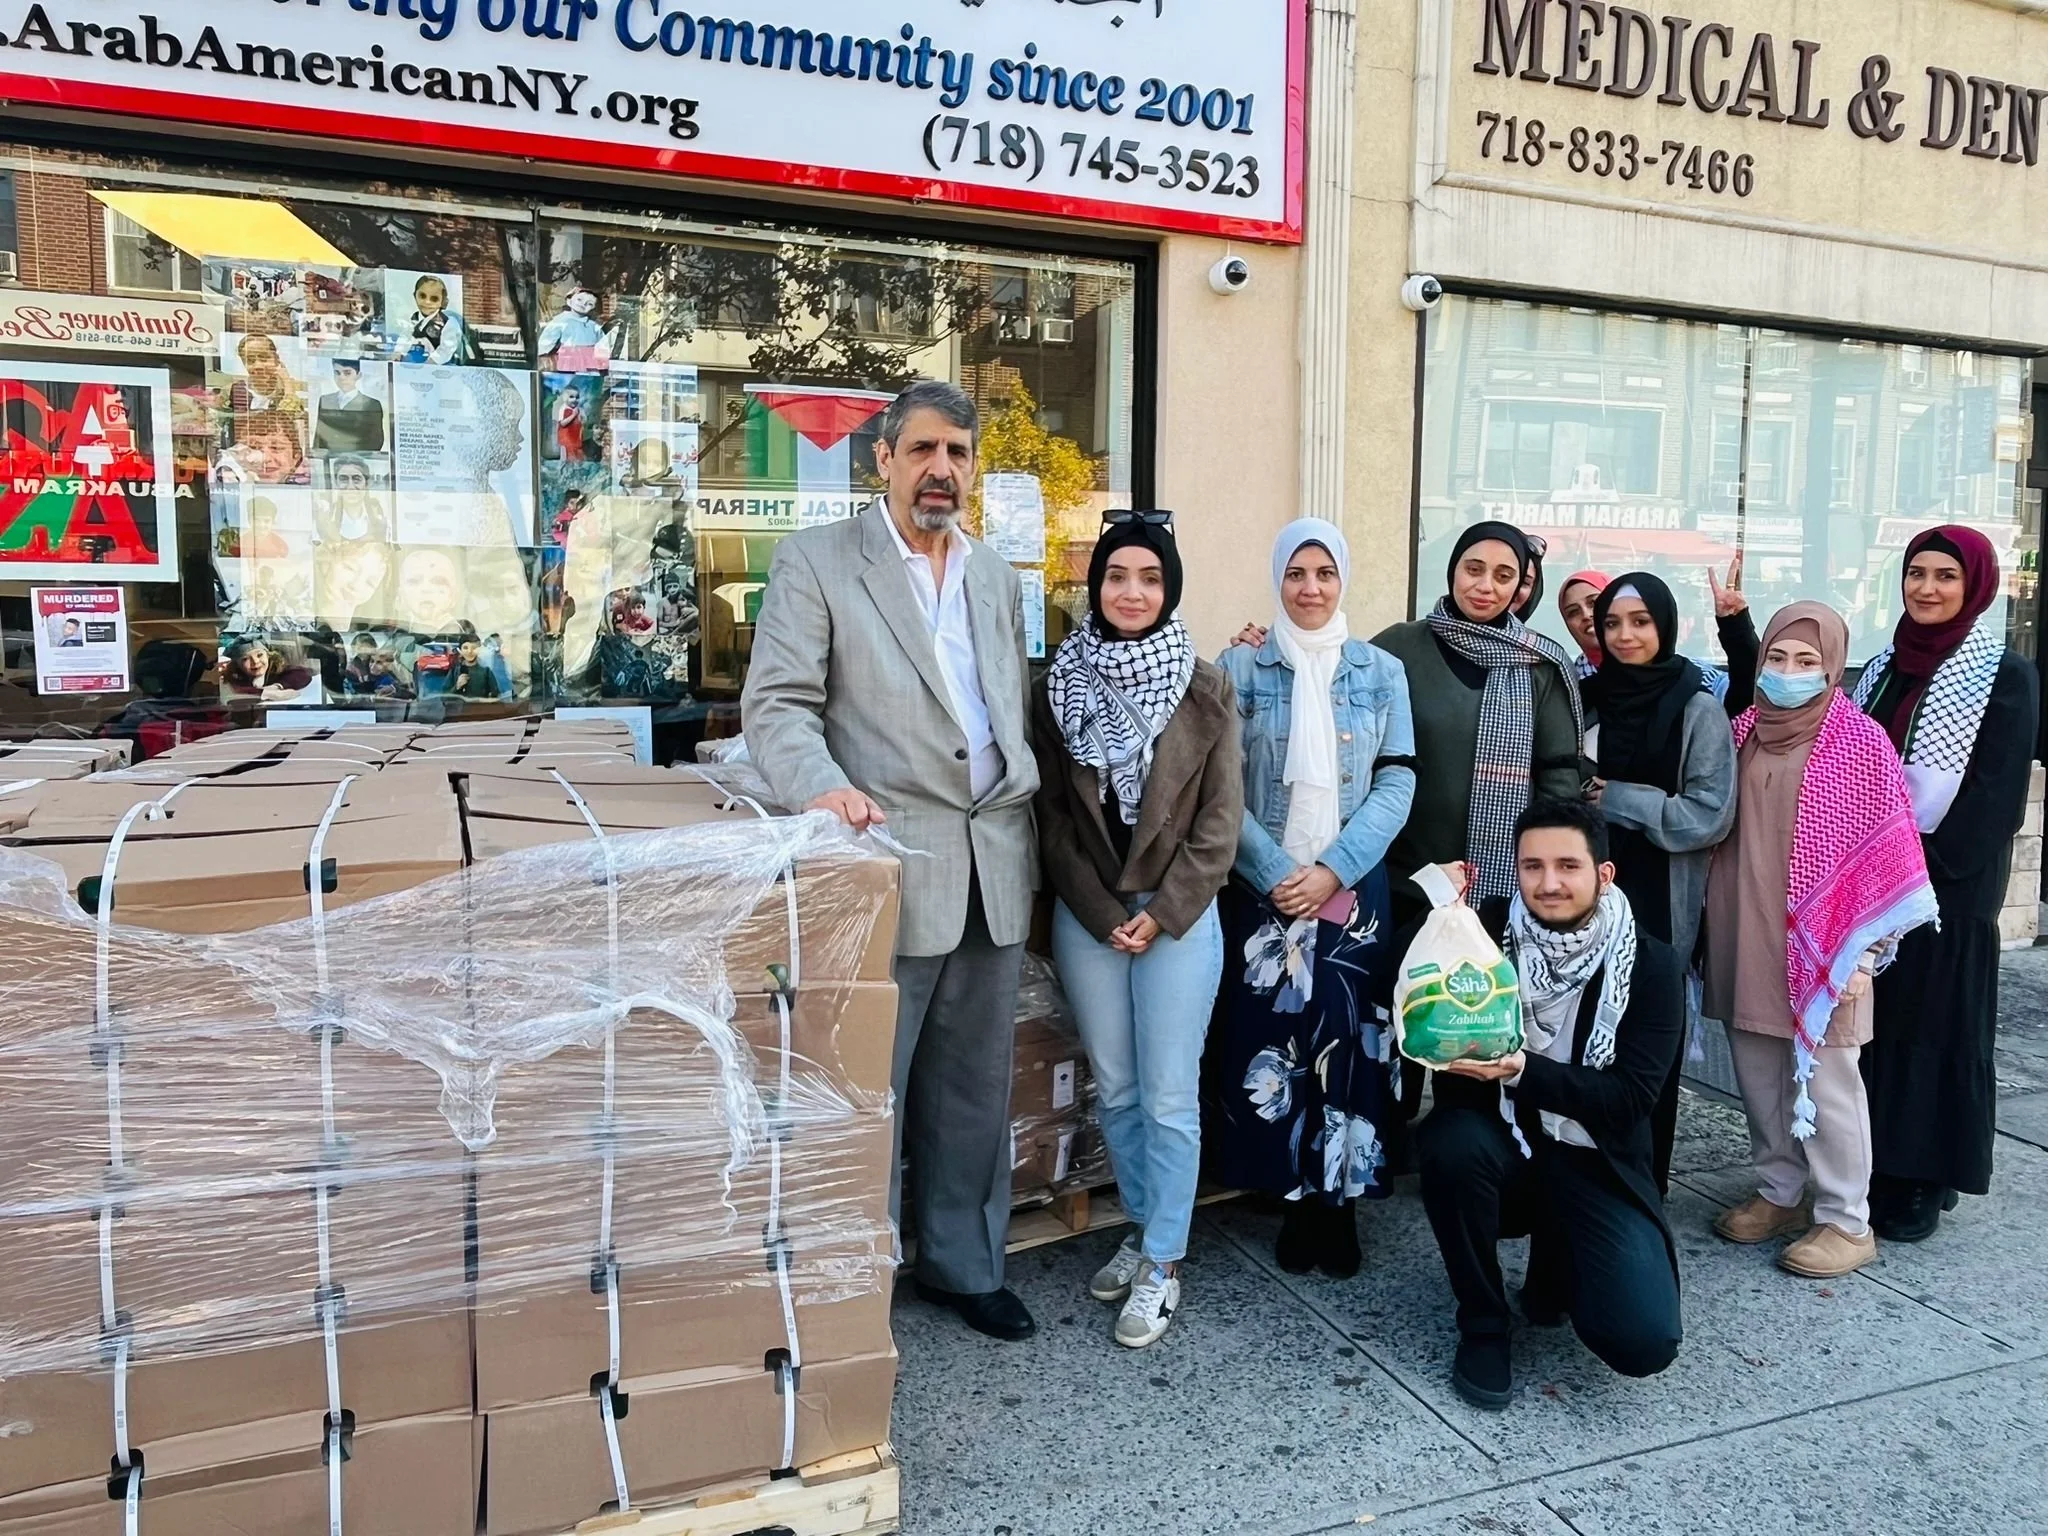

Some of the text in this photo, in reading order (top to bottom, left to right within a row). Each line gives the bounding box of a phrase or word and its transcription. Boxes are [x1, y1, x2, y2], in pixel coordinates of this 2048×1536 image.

[478, 0, 598, 41] our
[615, 0, 974, 109] Community
[988, 42, 1124, 115] since
[1135, 77, 1255, 135] 2001
[1473, 0, 2048, 167] MEDICAL & DEN
[922, 113, 1260, 198] (718) 745-3523
[1476, 110, 1755, 198] 718-833-7466
[43, 594, 114, 604] MURDERED
